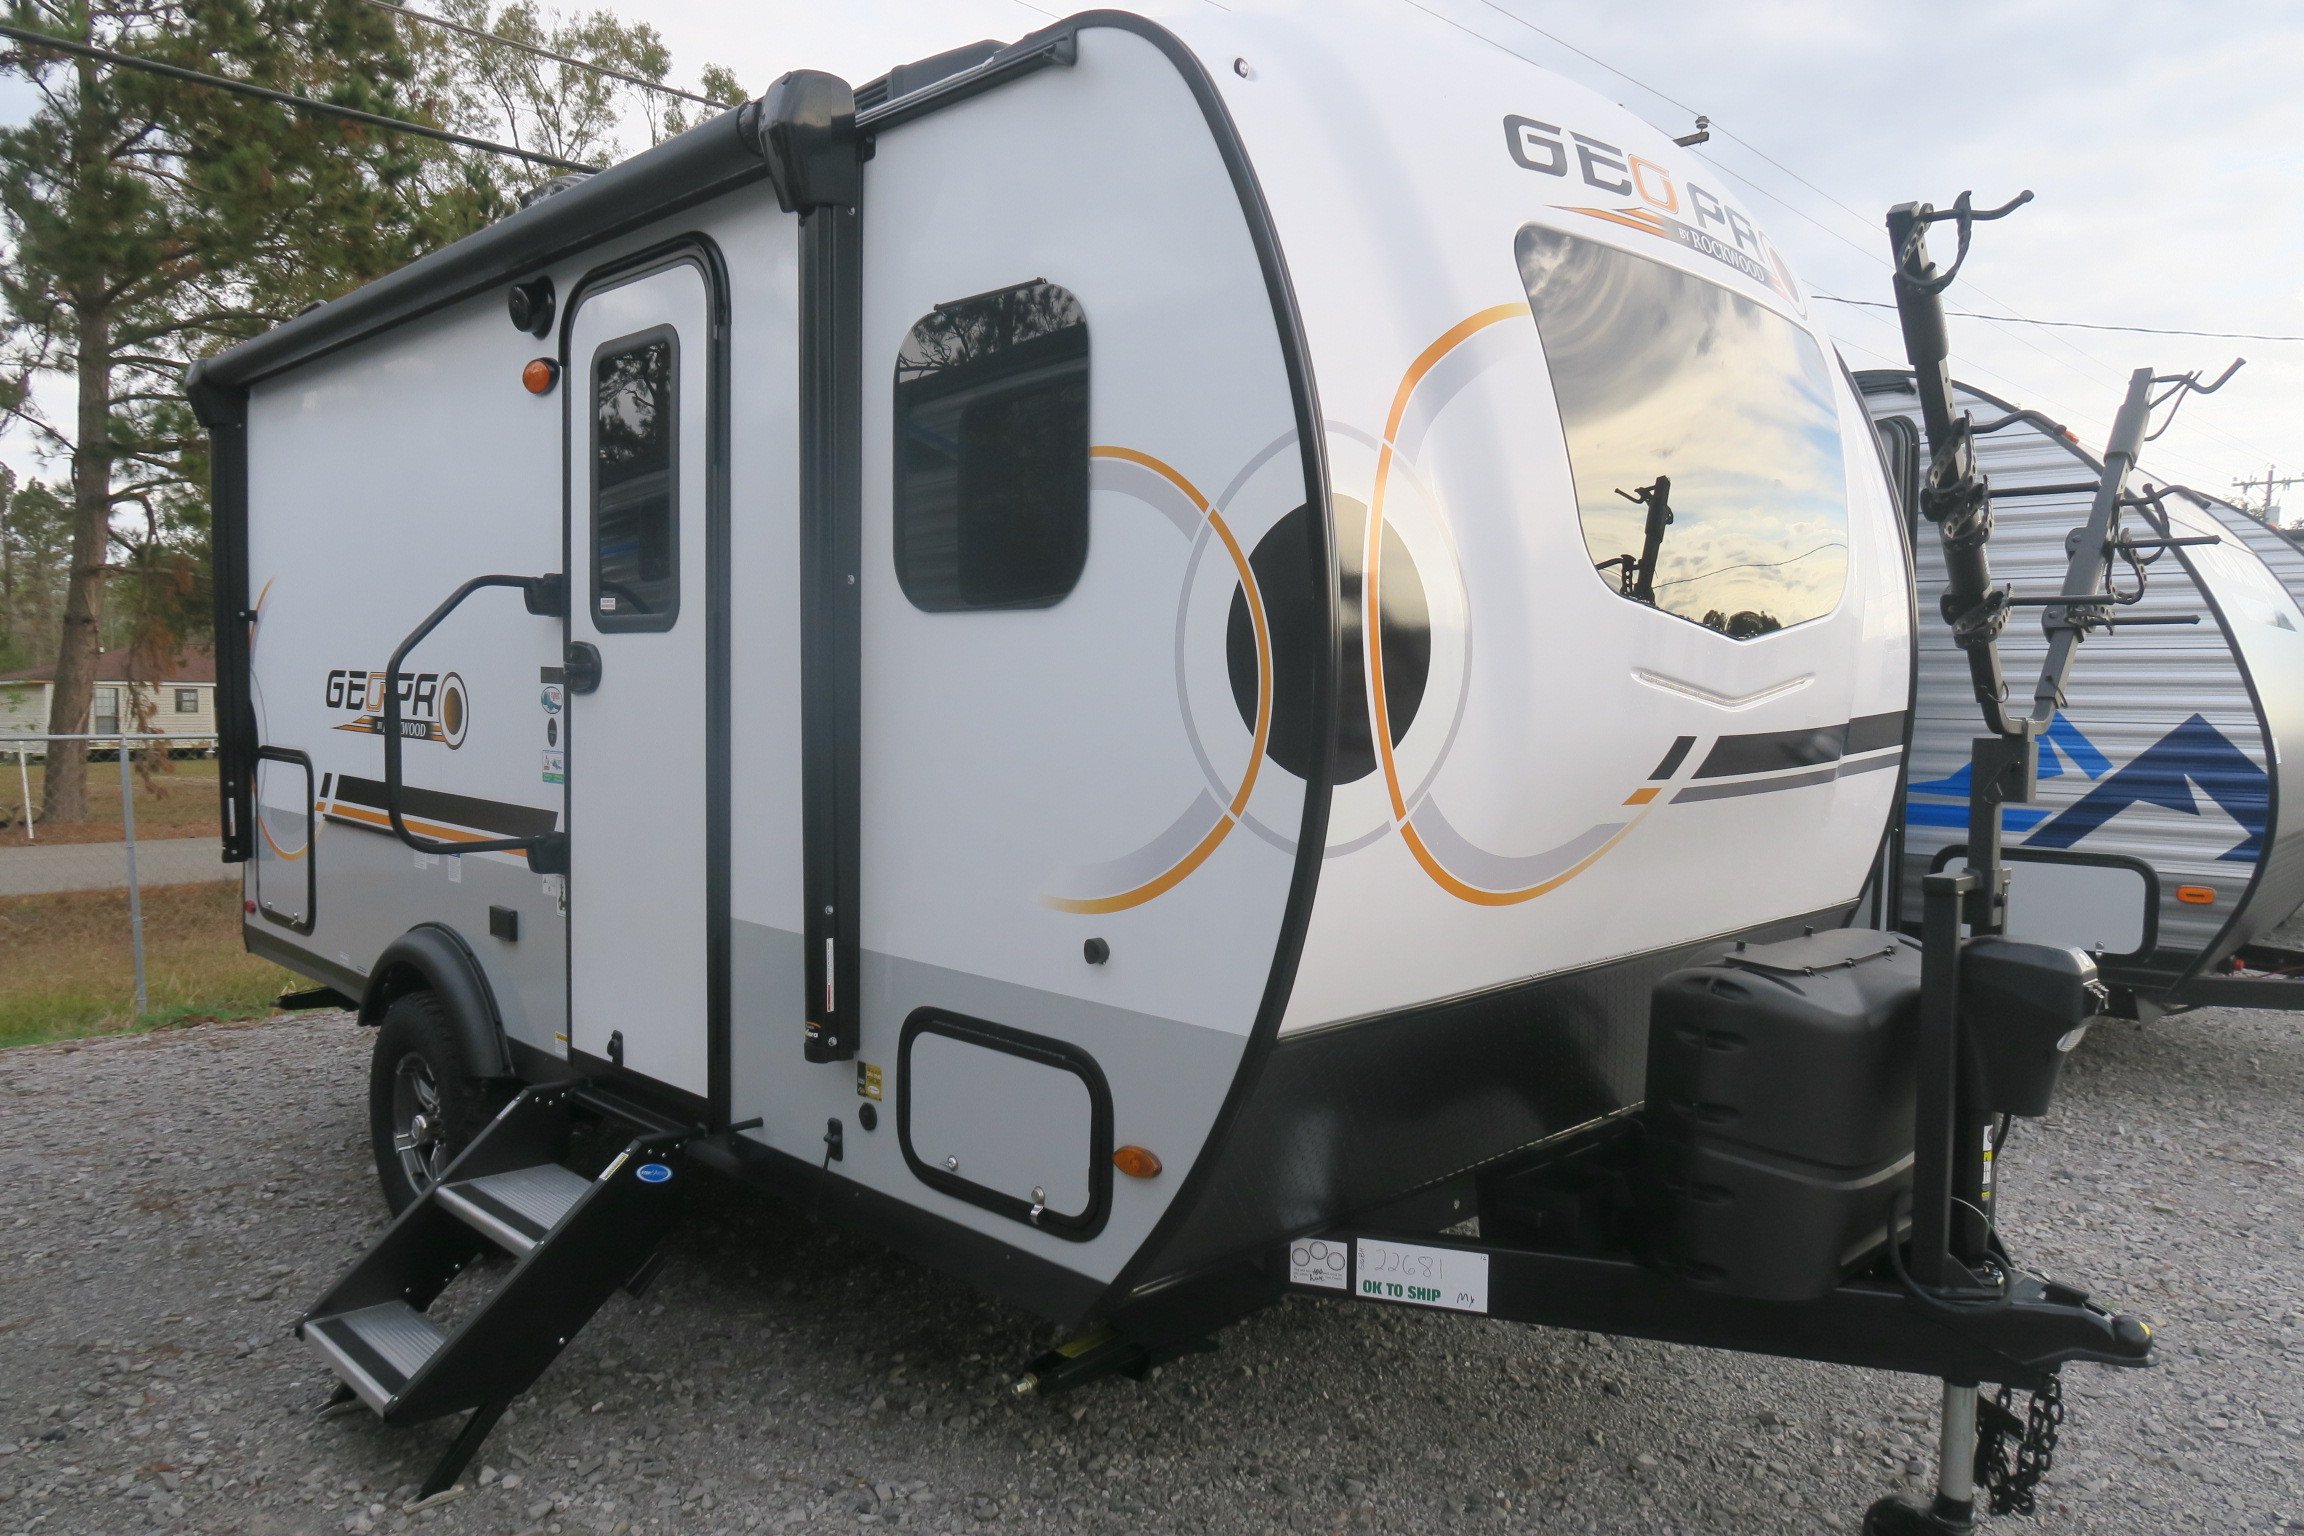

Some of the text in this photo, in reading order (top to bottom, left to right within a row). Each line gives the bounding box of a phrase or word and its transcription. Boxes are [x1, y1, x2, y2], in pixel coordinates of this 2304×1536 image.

[1678, 228, 1766, 283] BY ROCKWOOD
[1374, 1247, 1444, 1280] 22681
[1362, 1279, 1442, 1302] OK TO SHIP
